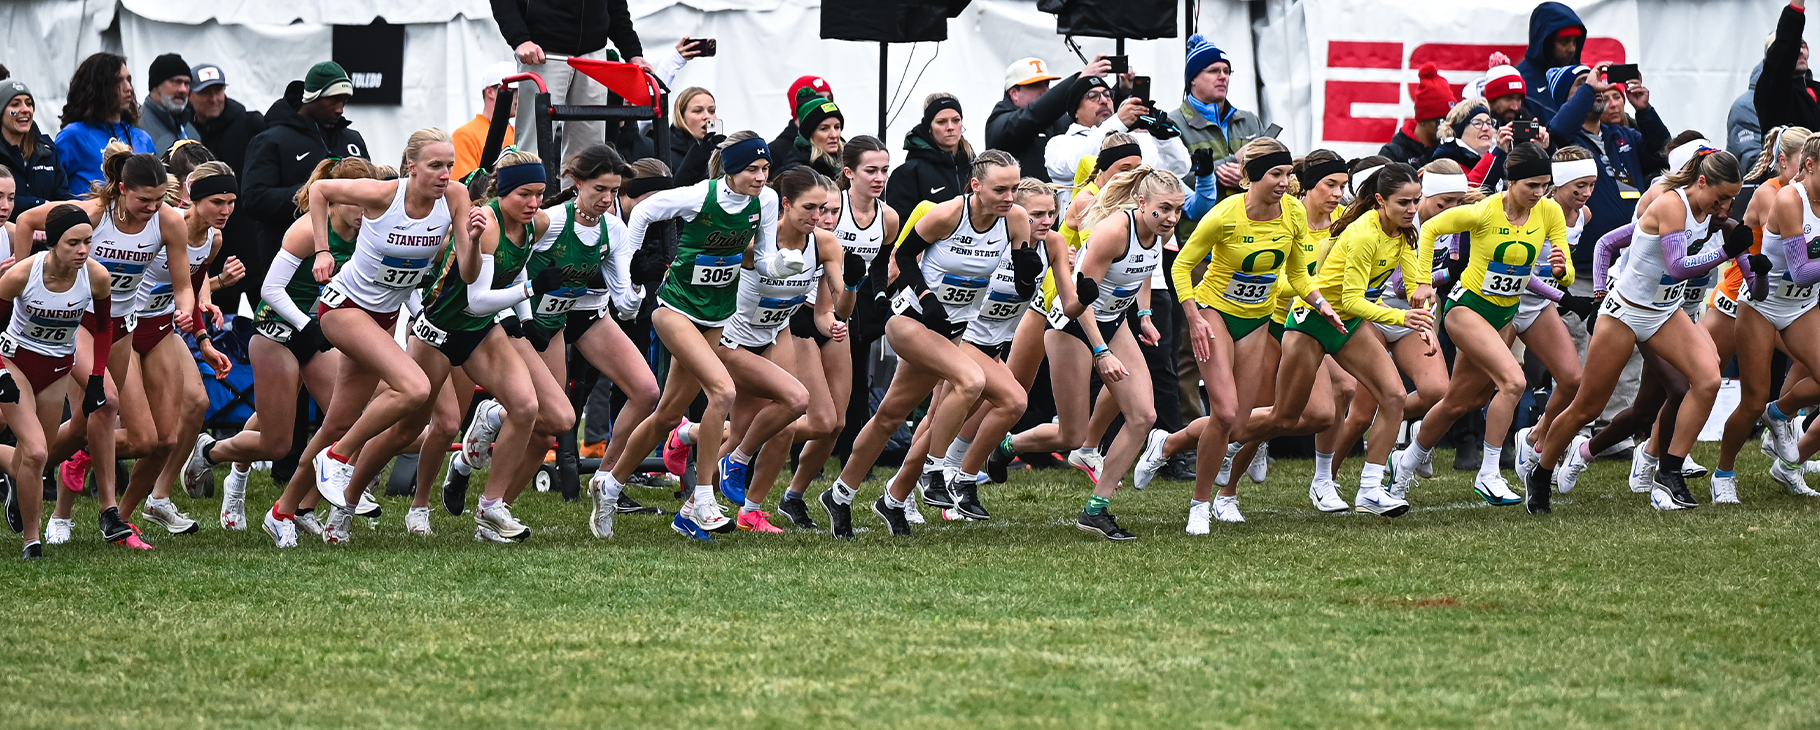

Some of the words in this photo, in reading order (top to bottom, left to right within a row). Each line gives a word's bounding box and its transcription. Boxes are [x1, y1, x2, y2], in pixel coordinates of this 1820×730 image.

[351, 72, 383, 89] TOLEDO
[387, 232, 441, 247] STANFORD
[95, 245, 154, 262] STANFORD
[950, 246, 973, 256] PENN
[974, 249, 1000, 257] STATE
[1684, 250, 1720, 268] GATORS
[384, 268, 420, 284] 377
[700, 268, 733, 283] 305
[759, 276, 785, 287] PENN
[996, 273, 1015, 283] PEN
[1233, 284, 1266, 297] 333
[1489, 275, 1523, 292] 334
[1663, 281, 1687, 300] 167
[1785, 284, 1813, 298] 173
[942, 288, 977, 303] 355
[26, 304, 84, 319] STANFORD
[546, 298, 577, 313] 313
[989, 303, 1020, 317] 354
[1717, 297, 1738, 314] 401
[760, 308, 792, 324] 345
[31, 328, 67, 341] 376
[416, 321, 439, 343] 308
